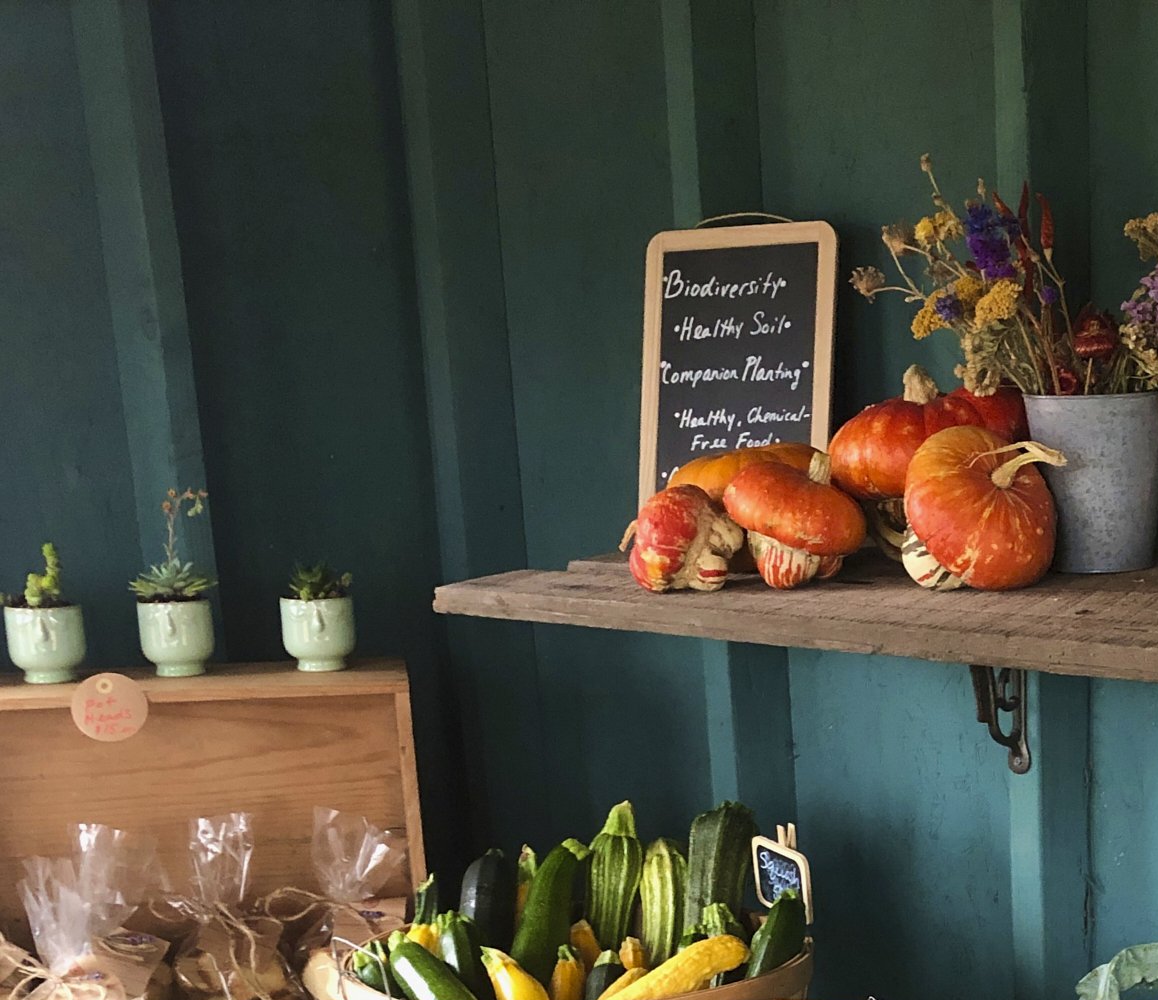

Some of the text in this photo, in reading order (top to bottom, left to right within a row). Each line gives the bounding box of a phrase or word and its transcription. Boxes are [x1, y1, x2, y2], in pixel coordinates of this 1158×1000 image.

[664, 268, 782, 299] Biodiversity
[680, 310, 785, 341] Healthy Soil
[661, 355, 801, 390] Companion Planting
[691, 433, 728, 451] Free
